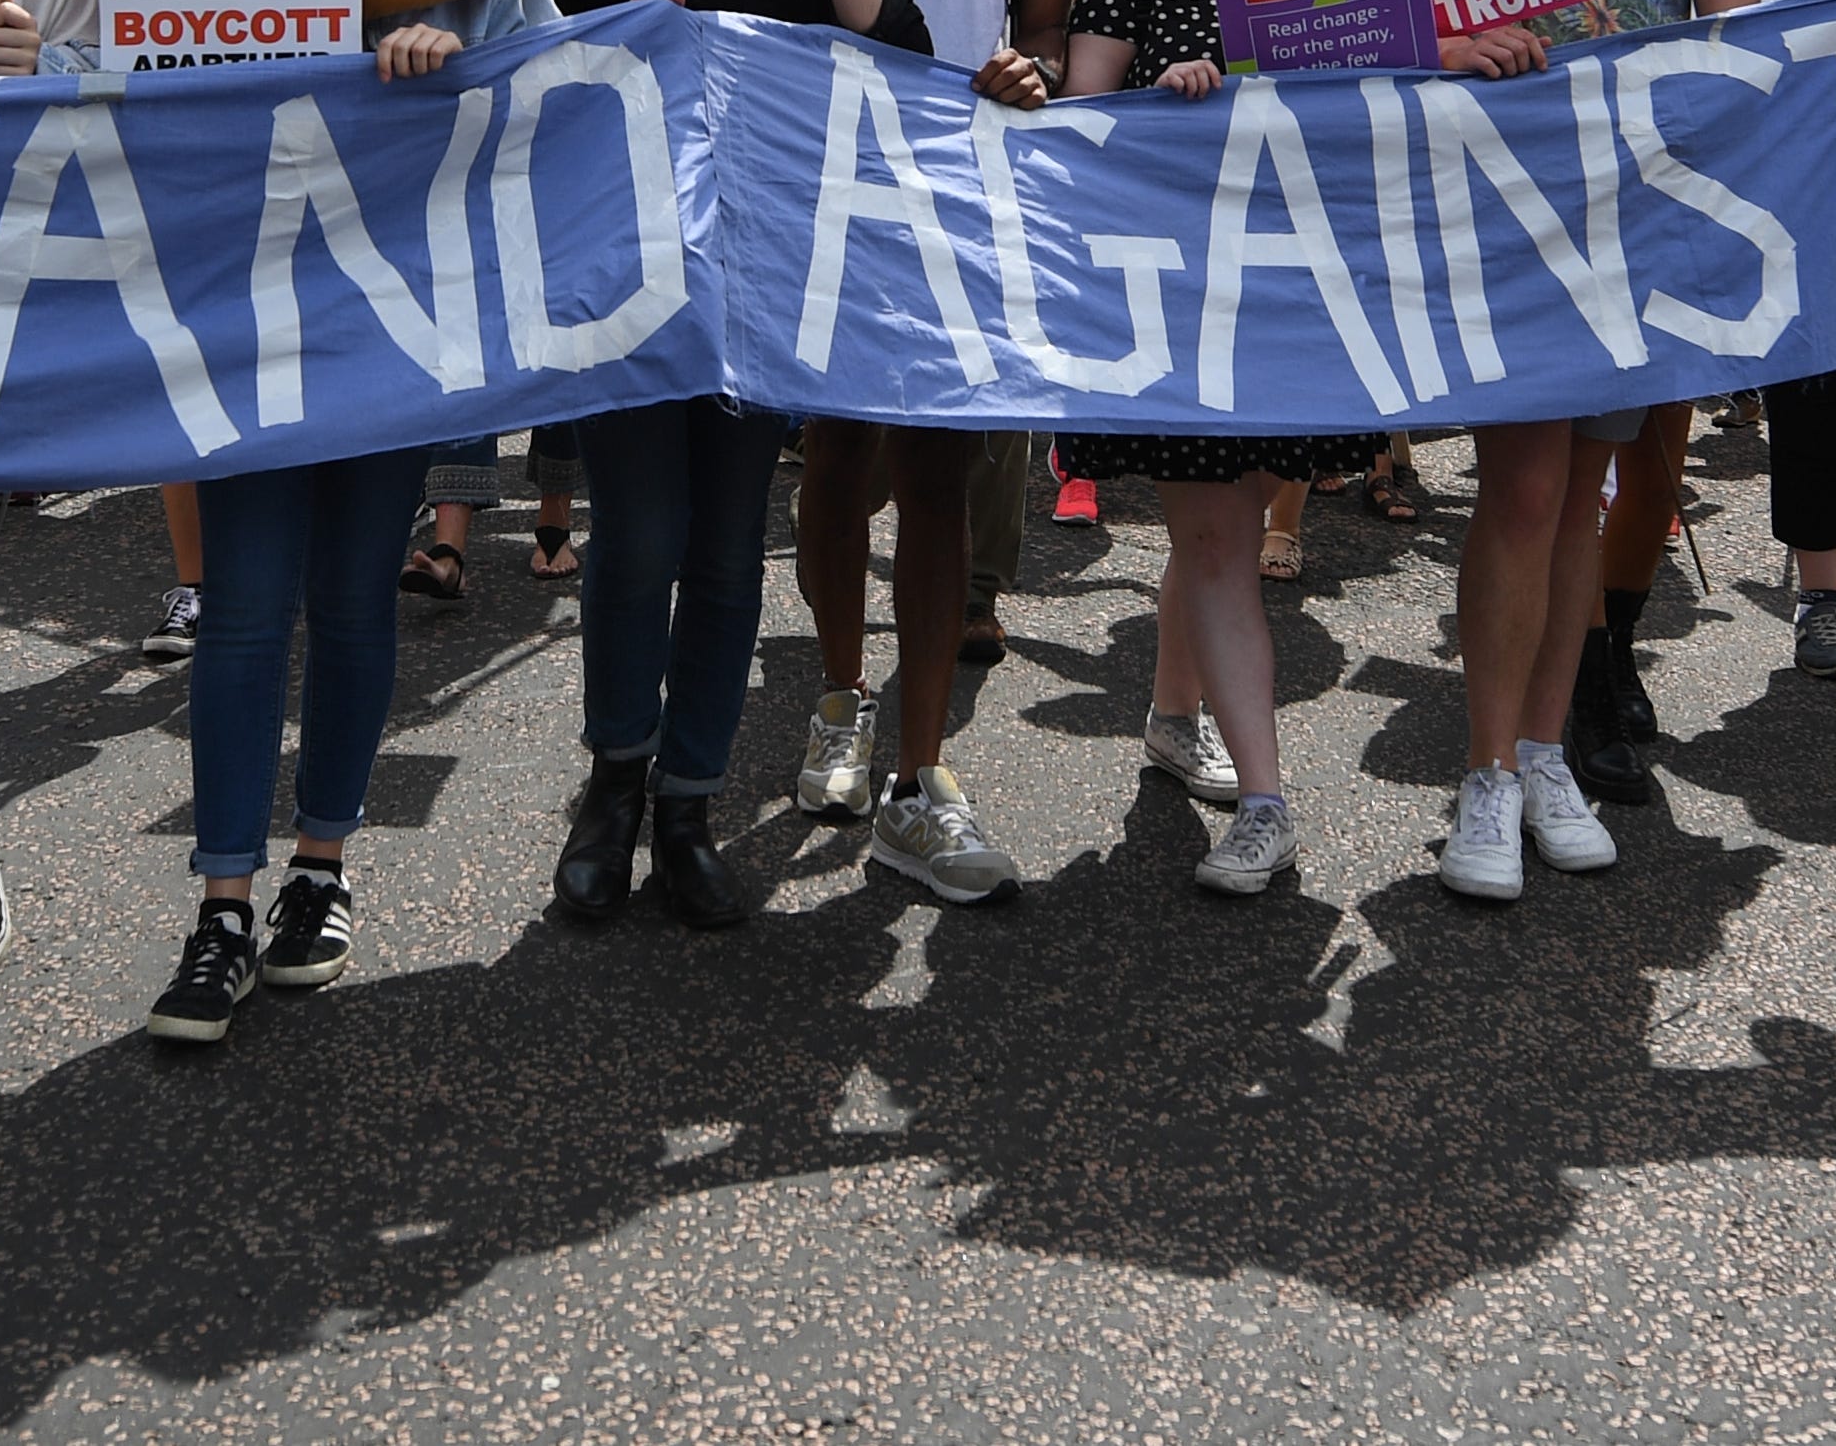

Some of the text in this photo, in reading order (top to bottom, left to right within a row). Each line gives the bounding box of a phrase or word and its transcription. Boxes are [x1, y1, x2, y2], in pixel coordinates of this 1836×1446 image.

[113, 8, 351, 46] BOYCOTT
[1268, 18, 1308, 38] Real
[1312, 7, 1379, 31] change
[1271, 27, 1395, 60] for the many,
[1314, 57, 1342, 71] the
[1346, 50, 1380, 68] few
